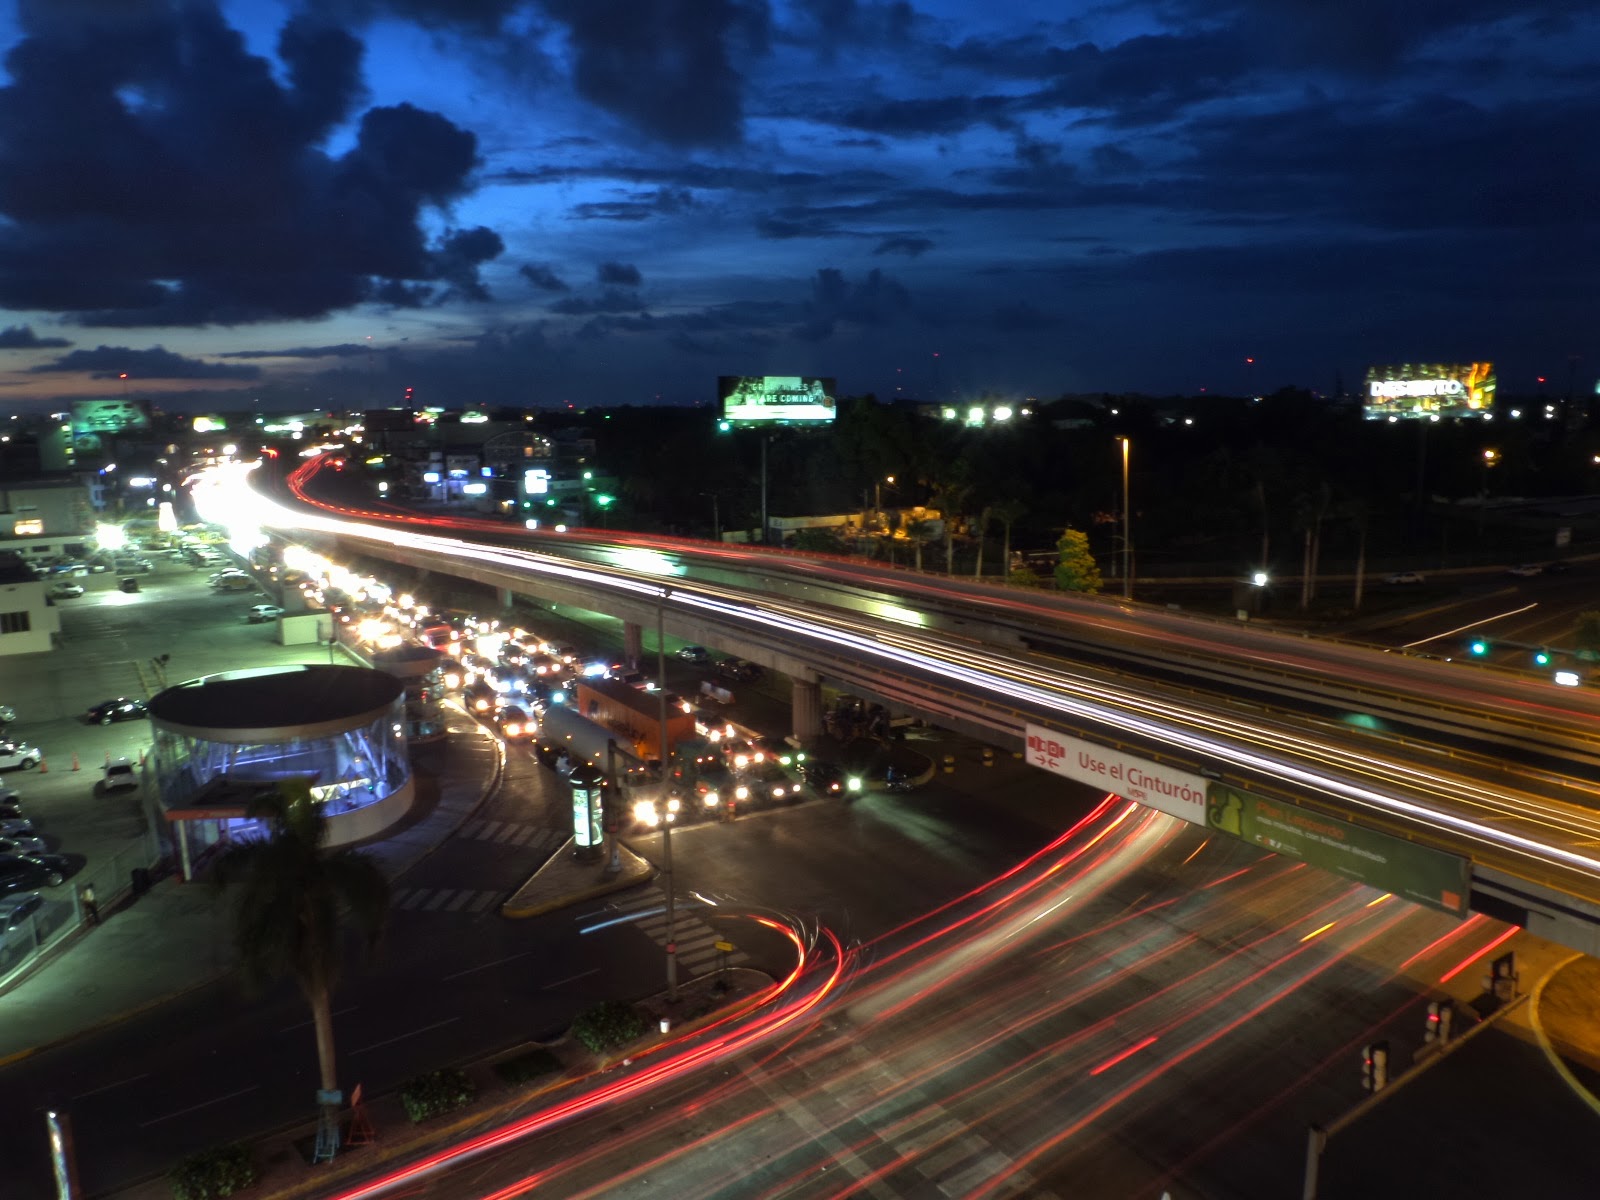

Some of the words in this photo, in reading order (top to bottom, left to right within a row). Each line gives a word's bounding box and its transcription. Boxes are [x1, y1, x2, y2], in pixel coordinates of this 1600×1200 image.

[780, 394, 814, 403] COMING
[1078, 752, 1106, 775] Use
[1110, 763, 1123, 781] el
[1127, 767, 1204, 806] Cinturón
